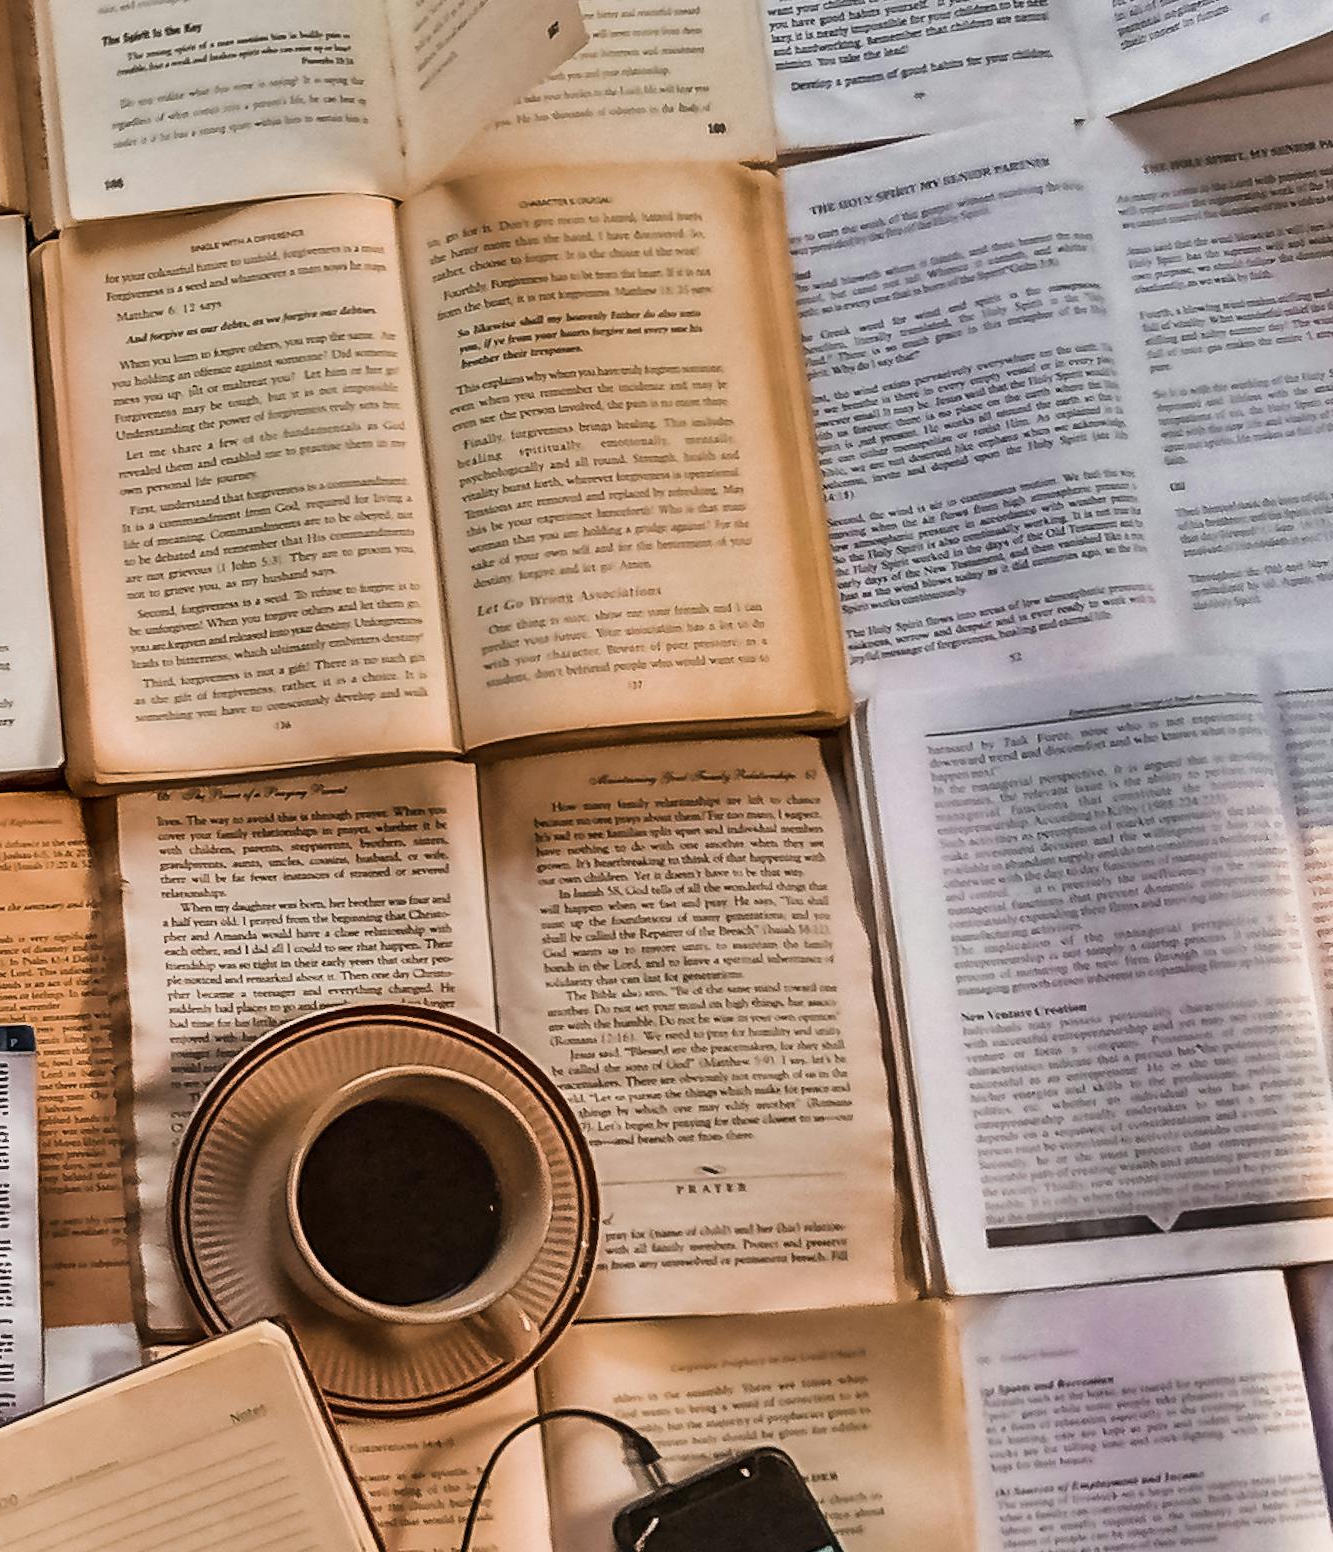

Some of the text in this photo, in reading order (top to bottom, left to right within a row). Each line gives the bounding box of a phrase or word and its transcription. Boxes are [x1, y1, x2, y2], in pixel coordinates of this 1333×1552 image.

[101, 35, 121, 47] The
[123, 31, 150, 45] Spirit
[164, 24, 181, 37] the
[184, 22, 203, 34] Key
[809, 156, 1050, 216] THE HOLY SPIRIT MY SENIOR PARTNER
[190, 240, 219, 253] SINGLE
[221, 238, 245, 248] WITH
[254, 229, 304, 244] DIFFERENCE
[116, 412, 265, 442] Understanding the power of
[477, 586, 661, 617] Let Go Wrong Associations
[185, 815, 207, 826] The
[209, 816, 229, 827] way
[191, 930, 209, 941] and
[214, 930, 258, 942] Amanda
[262, 928, 293, 939] would
[297, 927, 320, 938] have
[334, 926, 359, 938] close
[364, 924, 426, 938] relationship
[429, 924, 453, 934] with
[961, 1004, 1087, 1021] New Venture Creation
[10, 1038, 19, 1048] P
[676, 1181, 749, 1198] PRAYER
[229, 1403, 268, 1424] Notes
